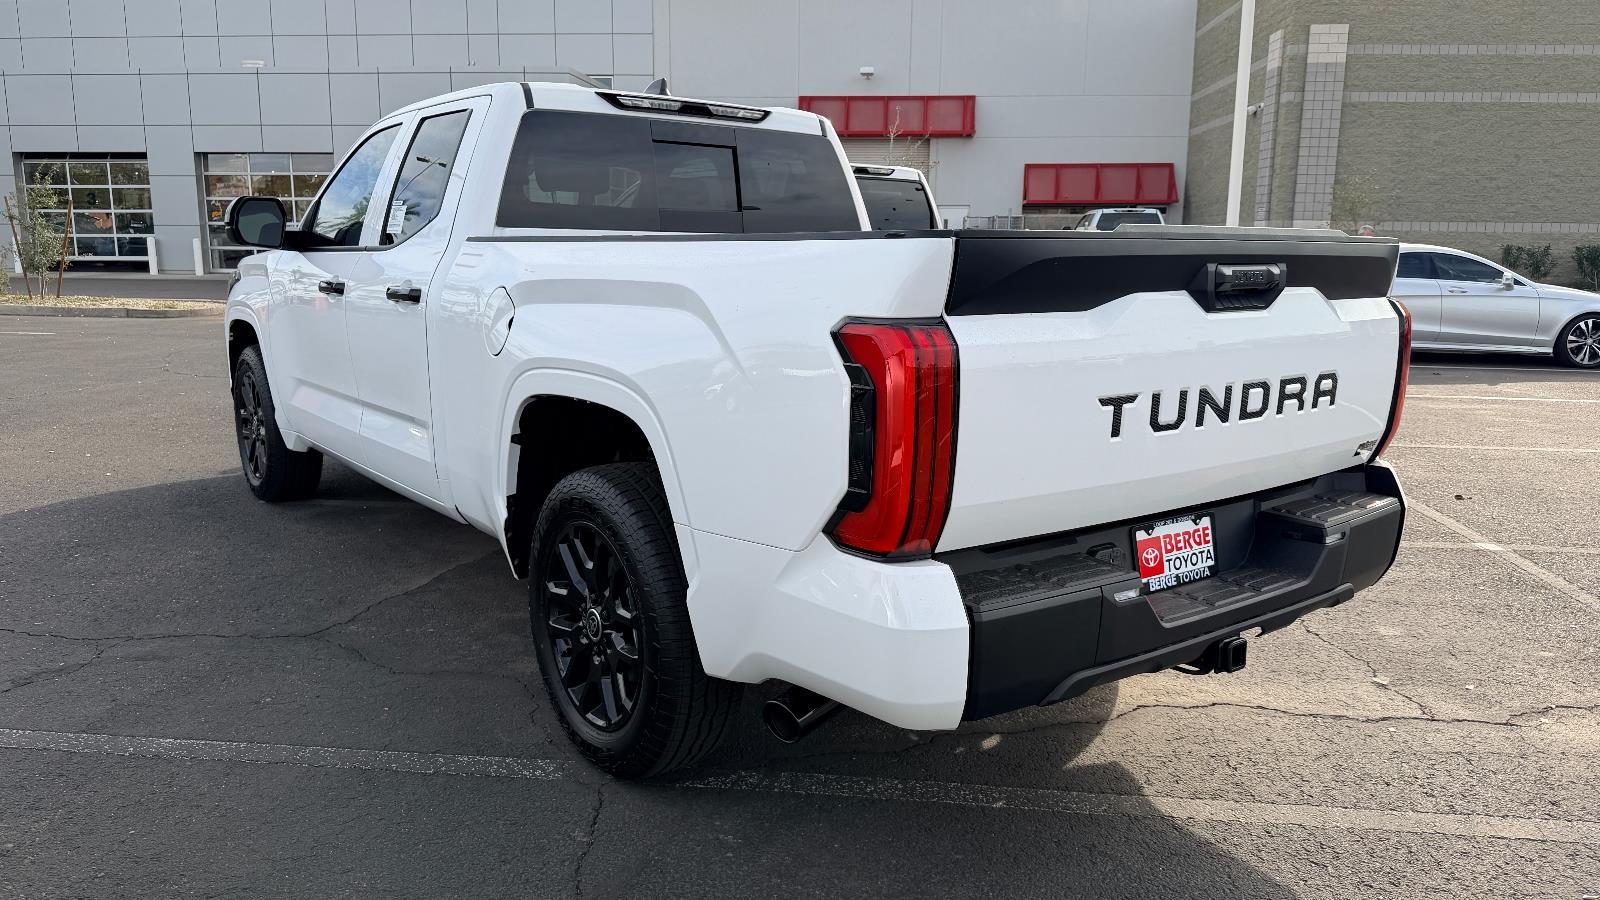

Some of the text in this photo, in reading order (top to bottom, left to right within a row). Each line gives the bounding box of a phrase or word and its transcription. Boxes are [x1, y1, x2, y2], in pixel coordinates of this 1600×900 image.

[1097, 371, 1339, 439] TUNDRA
[1162, 526, 1210, 554] BERGE
[1165, 549, 1213, 572] TOYOTA
[1149, 567, 1210, 591] BERGE TOYOTA
